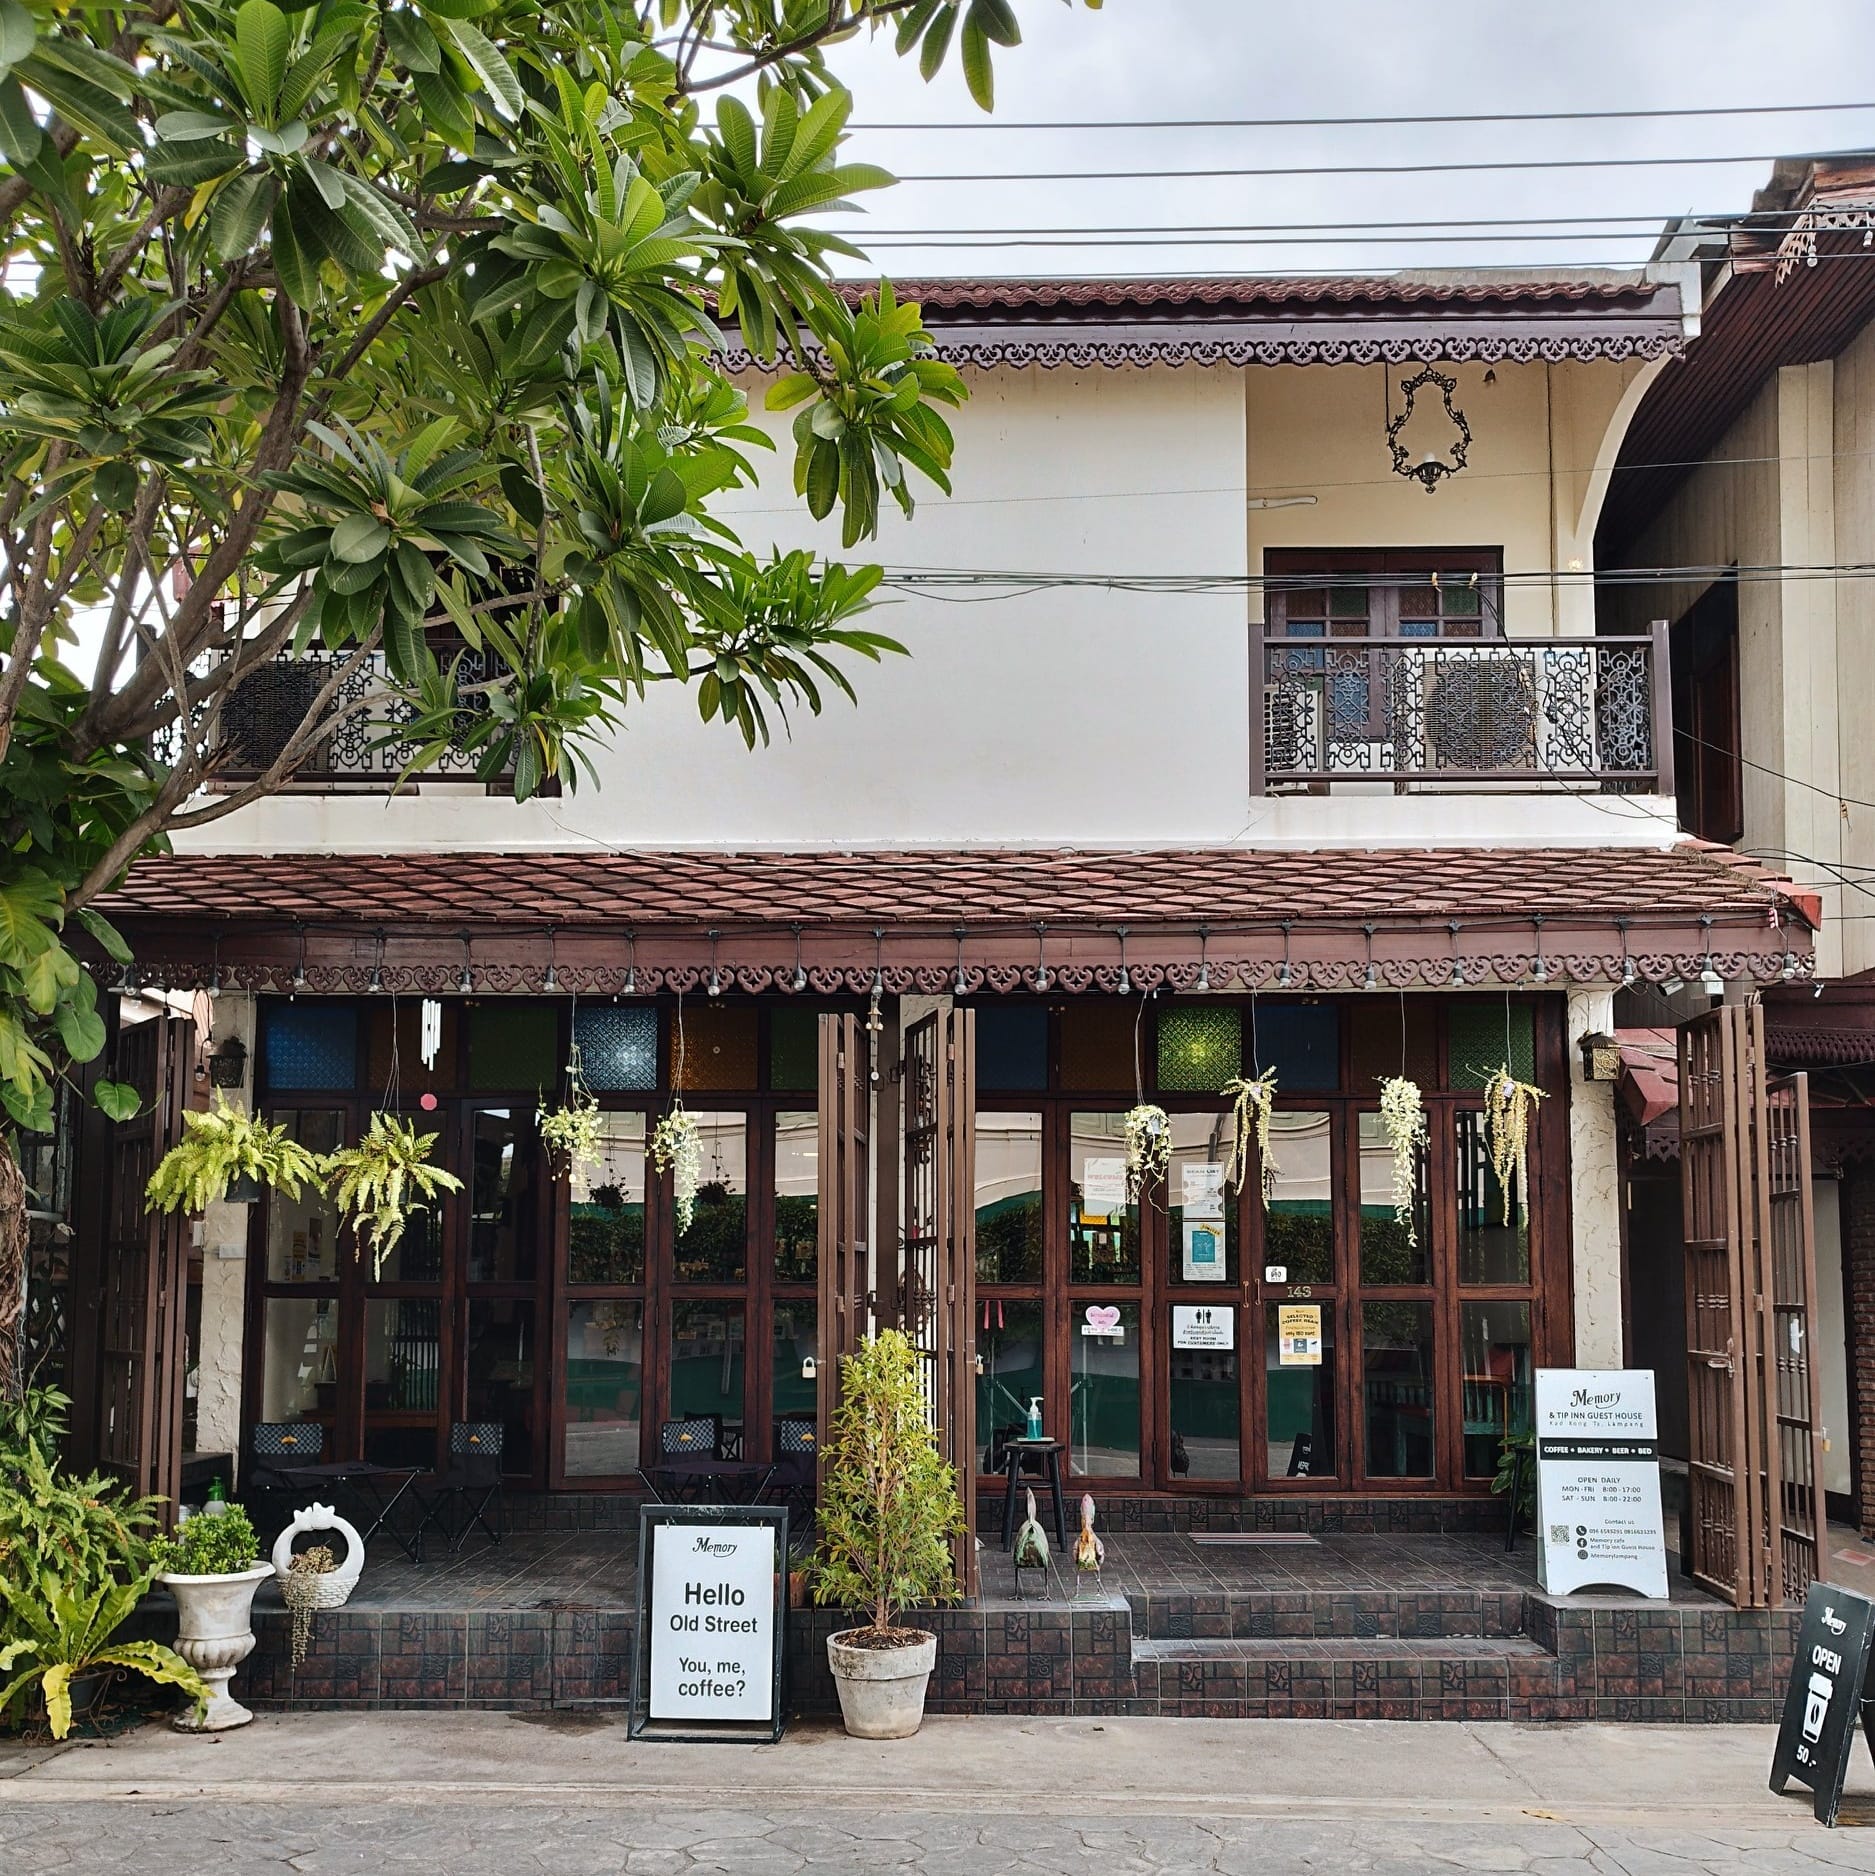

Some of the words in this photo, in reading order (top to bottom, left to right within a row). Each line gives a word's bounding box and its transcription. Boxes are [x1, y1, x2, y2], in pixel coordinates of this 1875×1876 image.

[1287, 1285, 1312, 1298] 143
[1570, 1388, 1621, 1409] Memory
[1549, 1411, 1555, 1419] &
[1557, 1411, 1569, 1419] TIP
[1570, 1411, 1585, 1419] INN
[1587, 1411, 1613, 1420] GUEST
[1615, 1412, 1643, 1420] HOUSE
[1544, 1446, 1569, 1454] COFFEE
[1577, 1446, 1603, 1455] BAKERY
[1612, 1447, 1630, 1455] BEER
[1637, 1447, 1653, 1455] BED
[1577, 1476, 1598, 1484] OPEN
[692, 1537, 738, 1558] Memory
[685, 1582, 745, 1606] Hello
[670, 1614, 699, 1632] Old
[704, 1615, 758, 1633] Street
[679, 1656, 712, 1676] You,
[717, 1660, 746, 1676] me,
[1812, 1644, 1842, 1675] OPEN
[678, 1679, 746, 1697] coffee?
